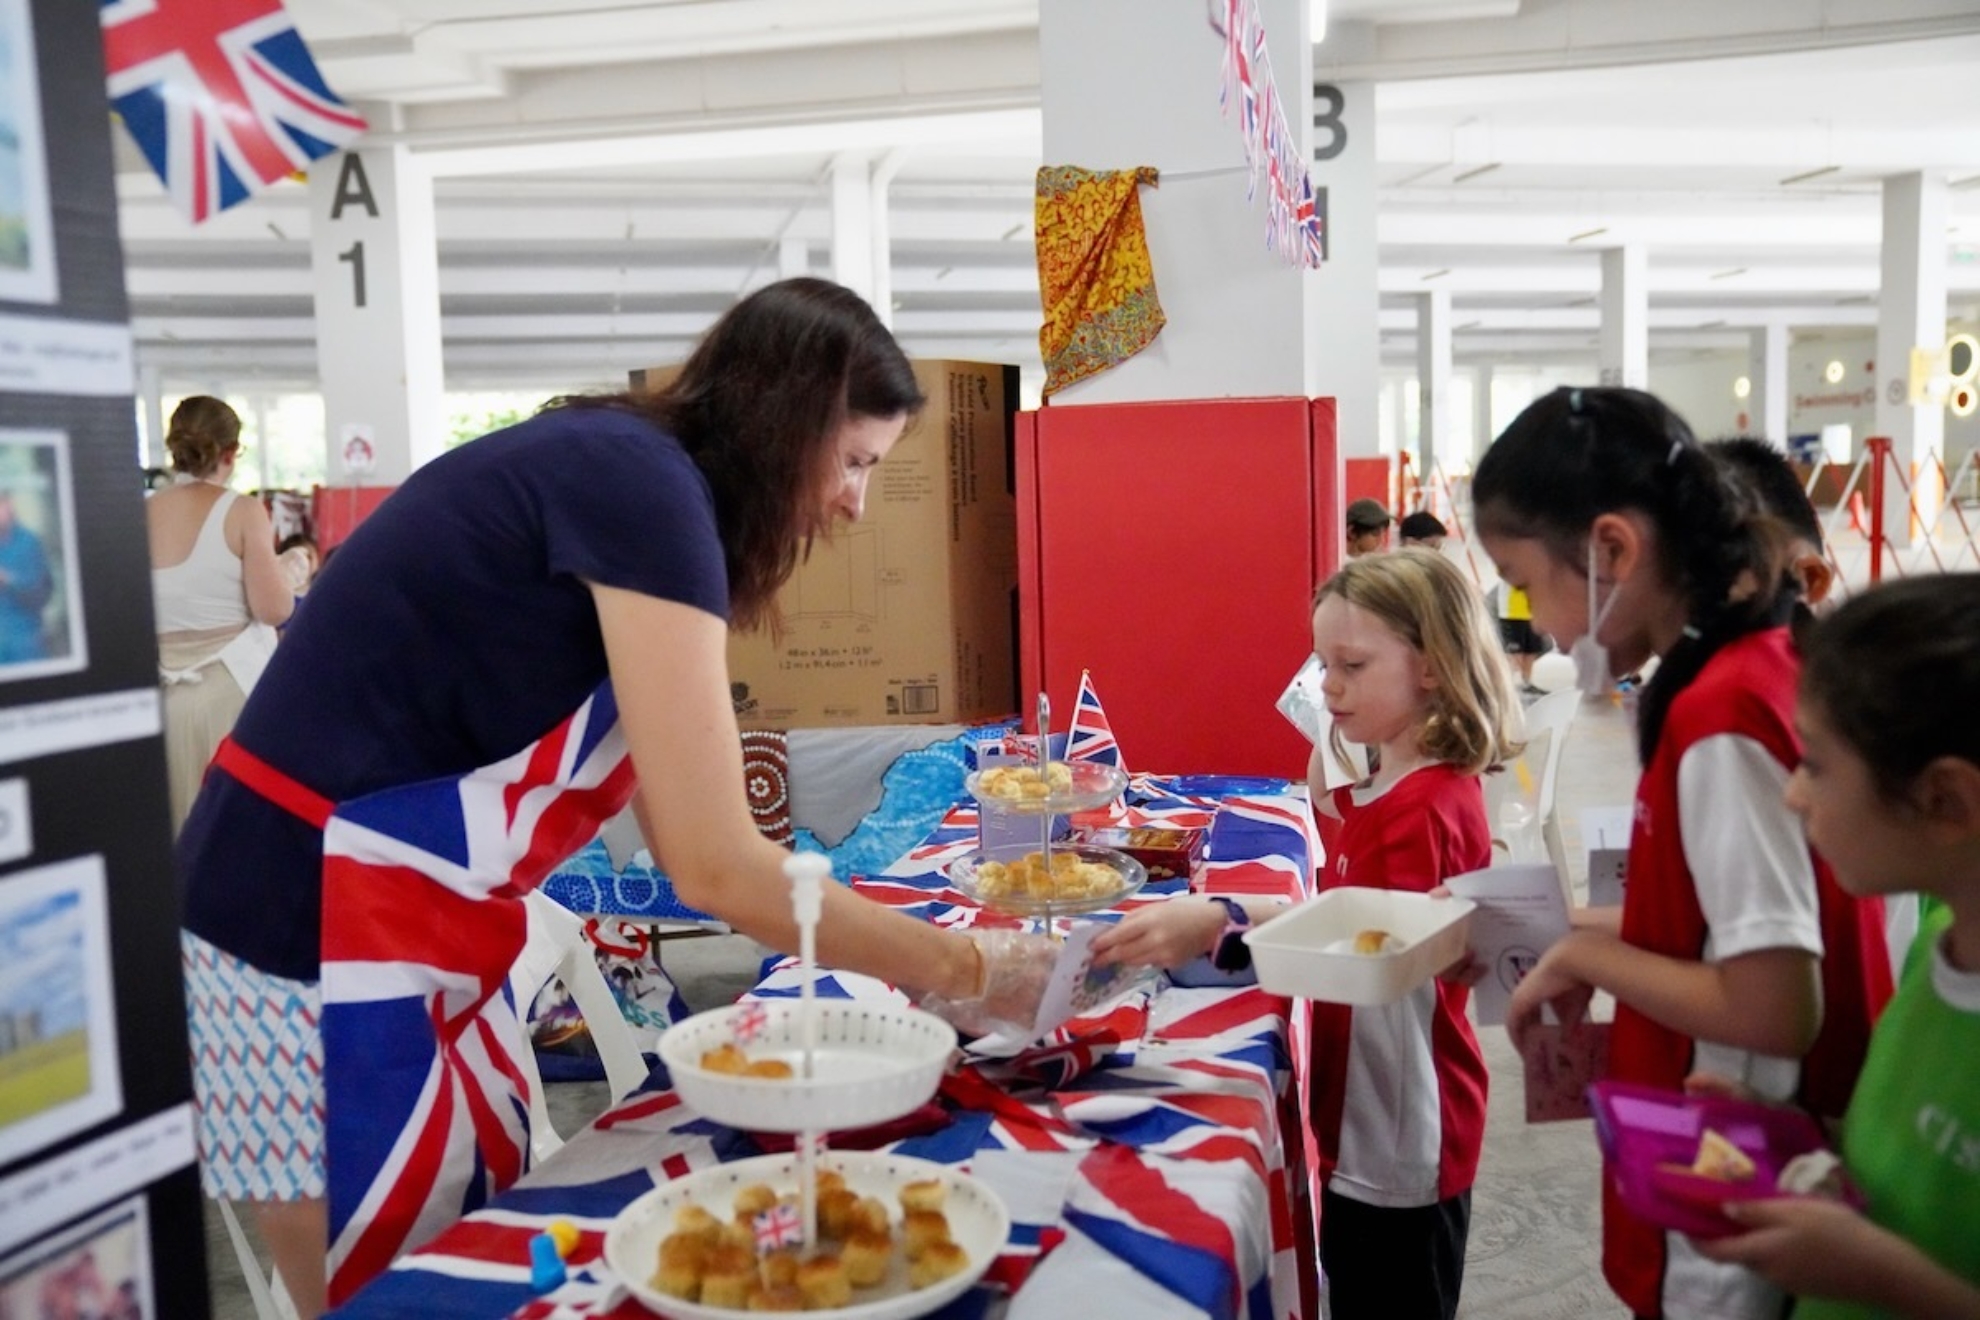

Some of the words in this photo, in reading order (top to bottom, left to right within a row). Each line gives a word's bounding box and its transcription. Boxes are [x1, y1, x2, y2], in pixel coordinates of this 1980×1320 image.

[1313, 84, 1347, 161] B
[331, 152, 380, 220] A
[338, 240, 367, 308] 1
